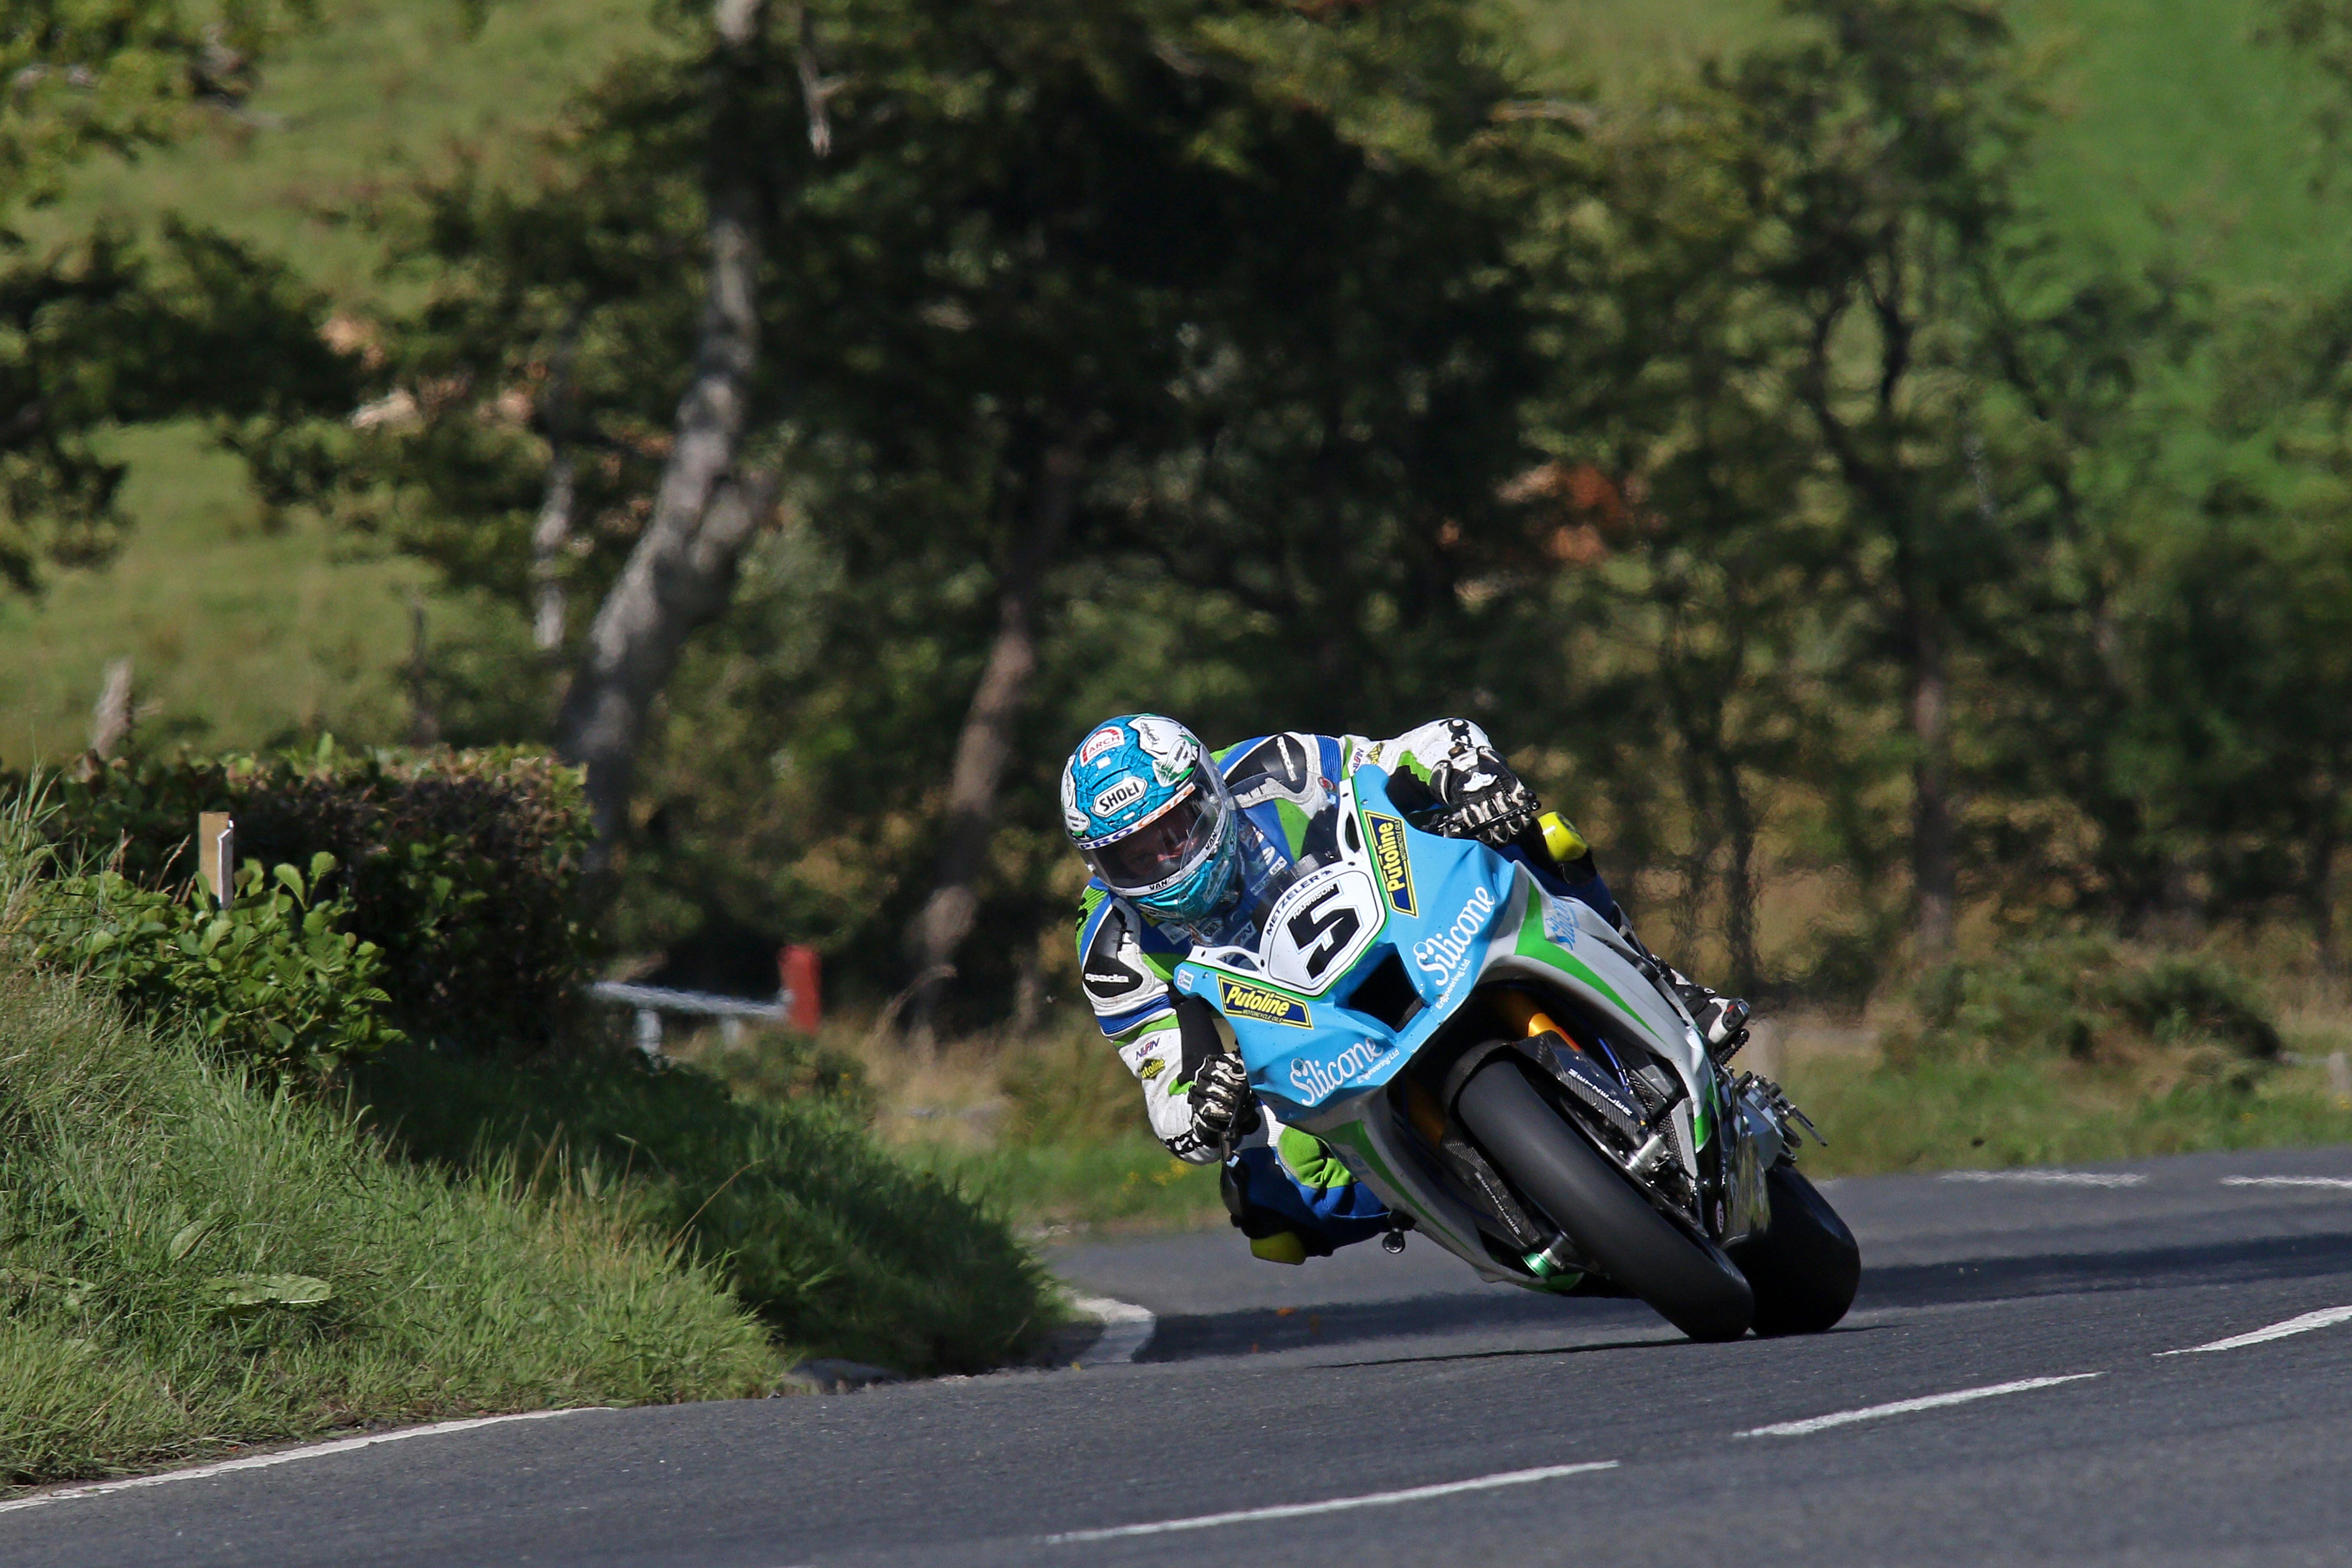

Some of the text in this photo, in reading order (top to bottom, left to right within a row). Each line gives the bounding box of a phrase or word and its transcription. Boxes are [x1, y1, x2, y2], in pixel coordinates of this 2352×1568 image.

[1089, 735, 1120, 754] ARCH
[1099, 782, 1139, 812] SHOEI
[1079, 828, 1133, 849] PRO
[1396, 831, 1406, 860] MOTORCYCLE
[1378, 822, 1406, 892] Putoline
[1266, 875, 1320, 936] METZELER
[1293, 884, 1334, 920] HARRISON
[1286, 881, 1362, 982] 5
[1413, 886, 1495, 986] Silicone
[1085, 973, 1129, 983] spada
[1436, 959, 1471, 1009] Engineering Ltd
[1226, 986, 1289, 1017] Putoline
[1242, 1009, 1272, 1021] MOTORCYCLE
[1141, 1059, 1165, 1079] utoline
[1390, 1048, 1400, 1060] Ltd
[1290, 1037, 1384, 1106] Silicone
[1568, 1068, 1633, 1116] METZELER
[1474, 1171, 1521, 1235] METZELER
